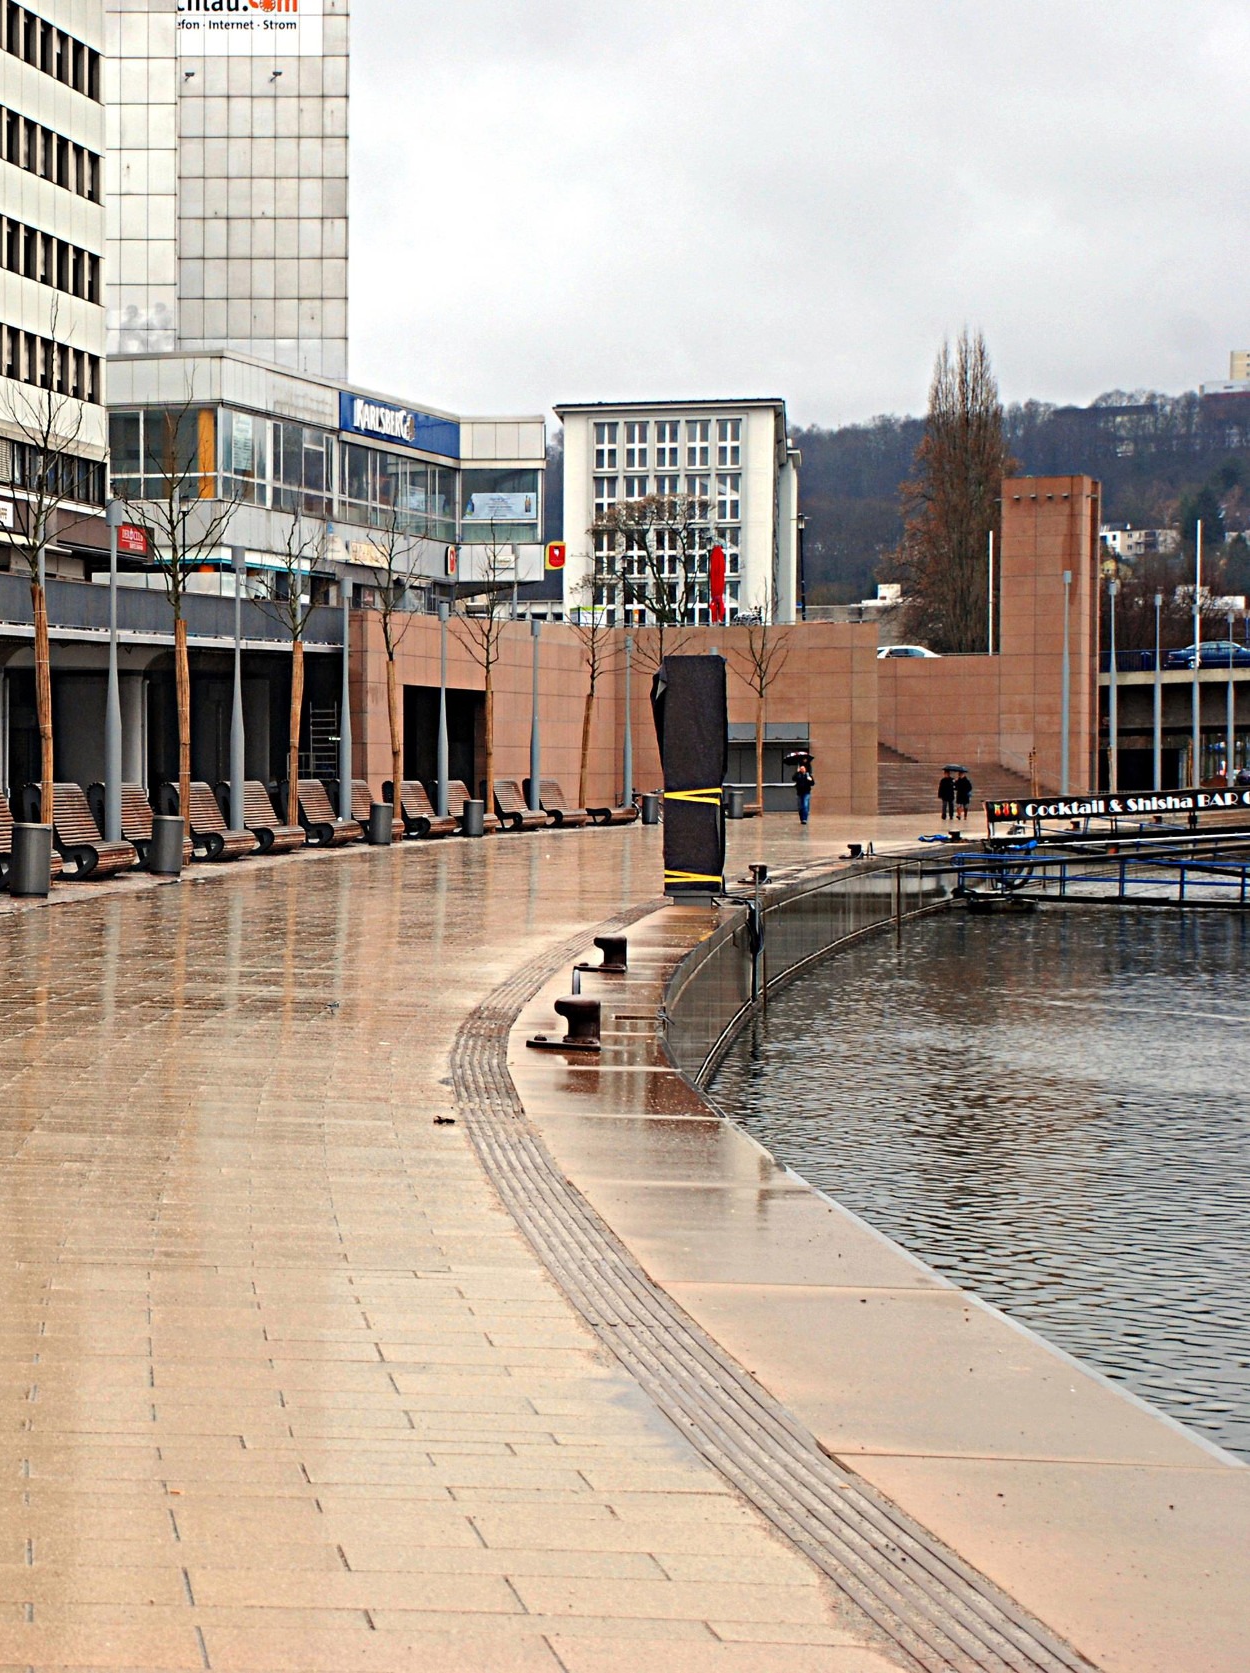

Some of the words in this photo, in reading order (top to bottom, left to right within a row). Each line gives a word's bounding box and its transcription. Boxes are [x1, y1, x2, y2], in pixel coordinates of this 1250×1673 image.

[208, 20, 254, 30] Internet
[263, 20, 297, 30] Strom
[1025, 799, 1105, 817] Cocktail
[1108, 799, 1123, 813] &
[1126, 796, 1194, 812] Shisha
[1197, 792, 1239, 807] BAR
